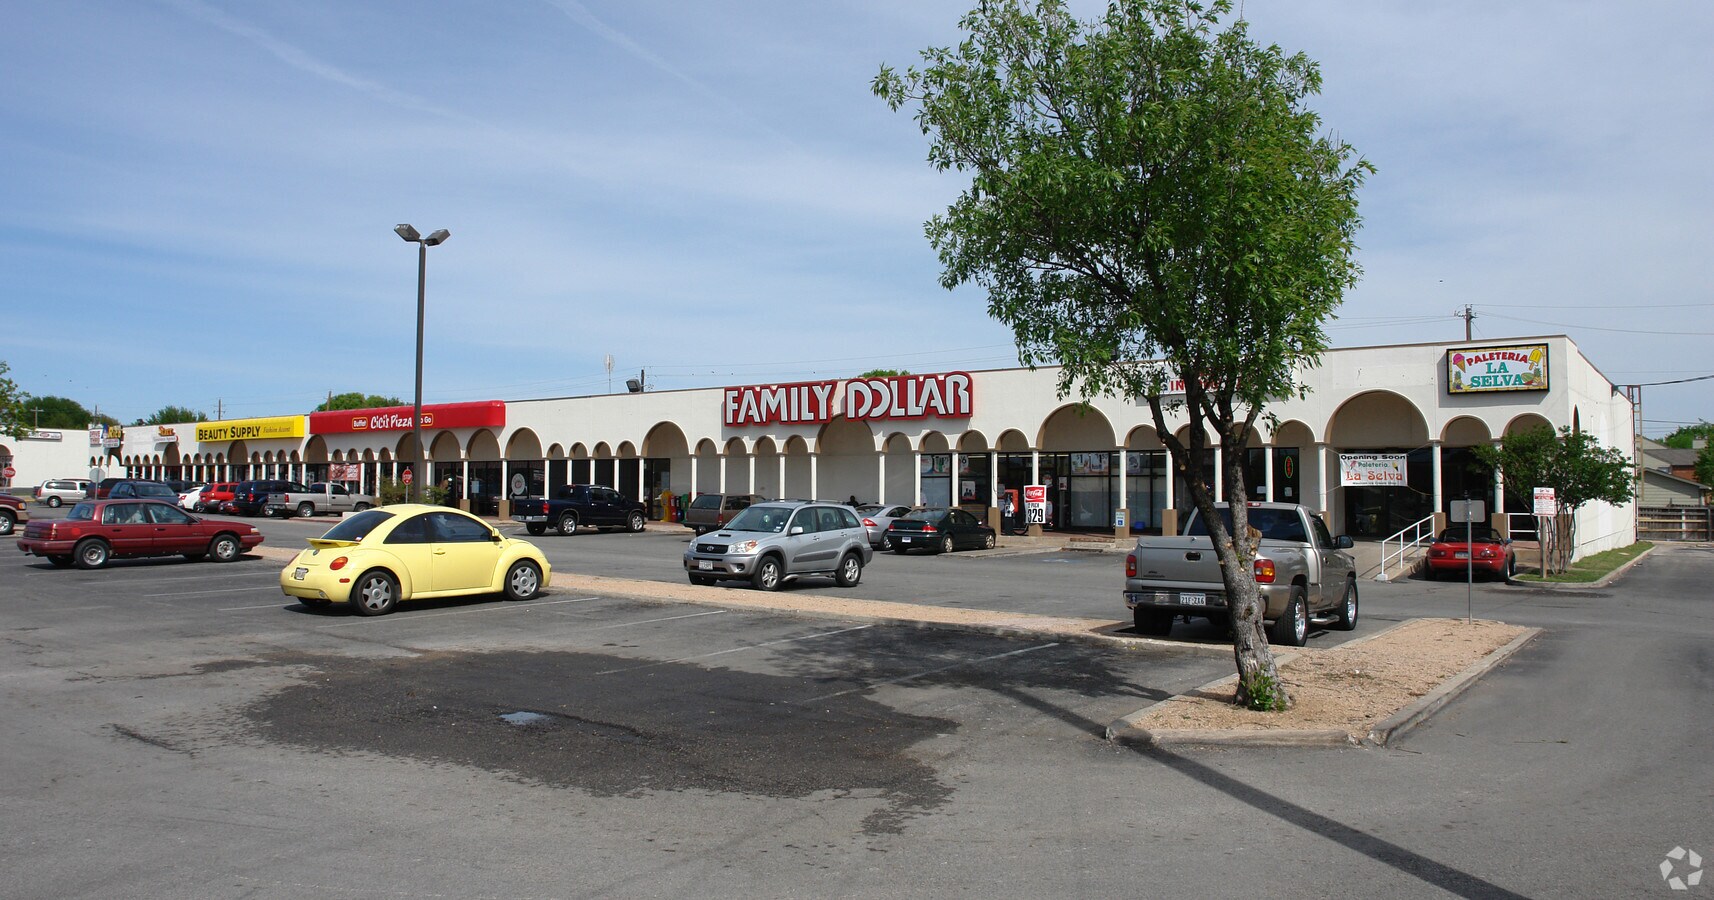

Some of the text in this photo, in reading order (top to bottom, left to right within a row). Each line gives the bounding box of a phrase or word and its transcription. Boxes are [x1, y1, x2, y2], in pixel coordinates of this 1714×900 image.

[1466, 352, 1528, 366] PALETERIA
[1486, 362, 1509, 374] LA
[1471, 374, 1525, 387] SELVA
[726, 375, 970, 424] FAMILY DOLLAR
[199, 428, 228, 440] BEAUTY
[231, 426, 260, 438] SUPPLY
[1346, 471, 1403, 480] La Selva
[1027, 508, 1044, 523] 329
